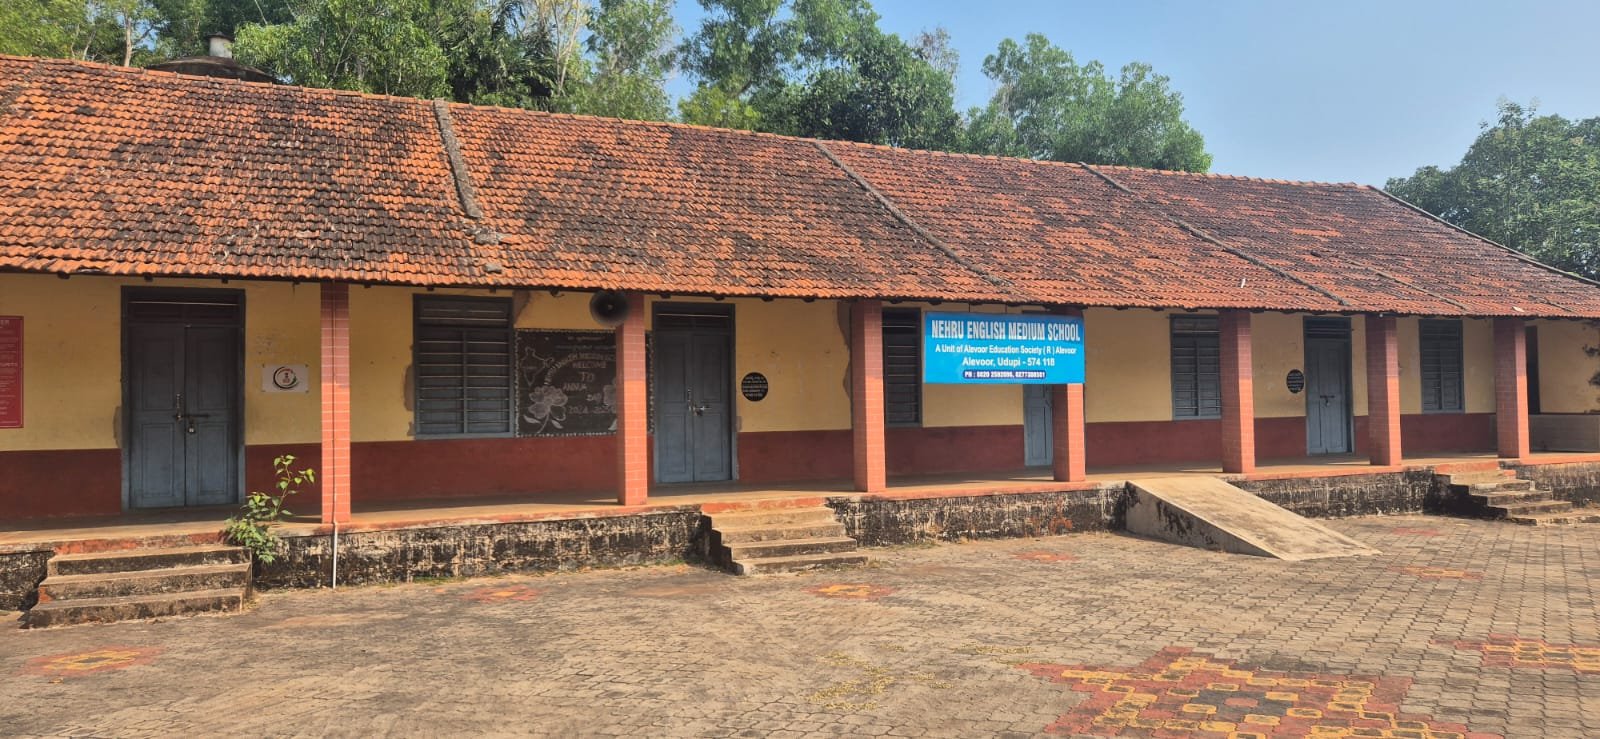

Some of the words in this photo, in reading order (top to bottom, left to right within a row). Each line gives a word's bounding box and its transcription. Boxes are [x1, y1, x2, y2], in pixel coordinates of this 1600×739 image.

[931, 319, 964, 339] NEHRU
[967, 320, 1006, 340] ENGLISH
[1008, 321, 1045, 341] MEDIUM
[1047, 322, 1080, 342] SCHOOL
[935, 344, 941, 352] A
[941, 344, 955, 353] Unit
[956, 344, 963, 353] of
[963, 344, 987, 353] Alevoor
[989, 345, 1019, 353] Education
[1020, 345, 1042, 356] Society
[1055, 347, 1077, 355] Alevoor
[962, 357, 996, 367] Alevoor,
[997, 357, 1021, 368] Udupi
[1027, 357, 1040, 366] 574
